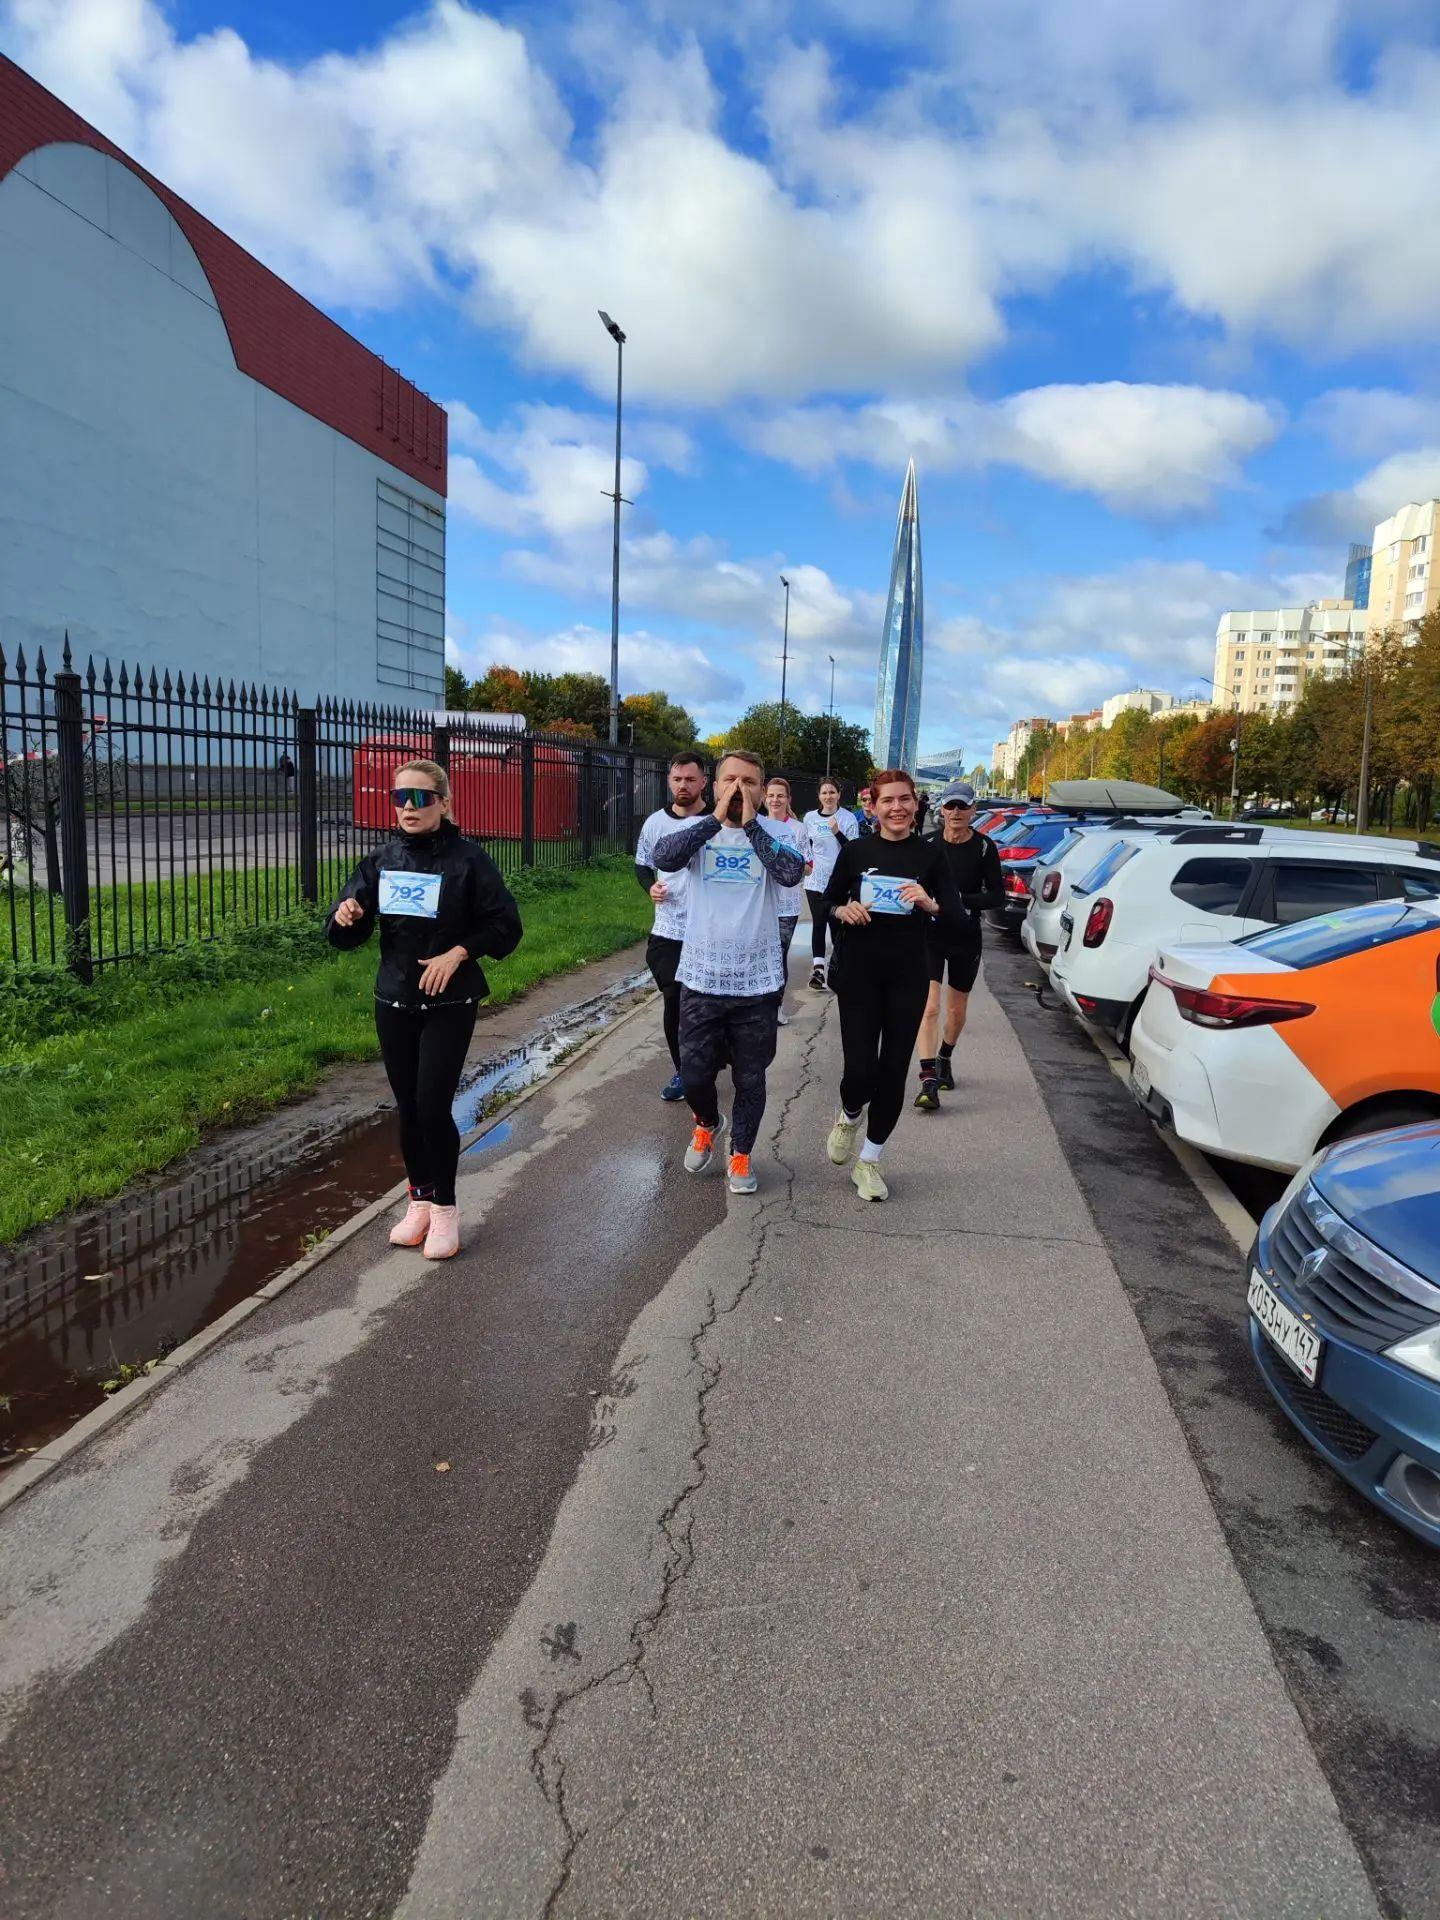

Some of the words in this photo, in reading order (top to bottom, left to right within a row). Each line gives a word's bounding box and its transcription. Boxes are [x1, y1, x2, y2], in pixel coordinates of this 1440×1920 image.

[715, 855, 751, 869] 892
[389, 886, 425, 901] 792
[872, 888, 903, 901] 747
[1294, 1326, 1314, 1359] 147
